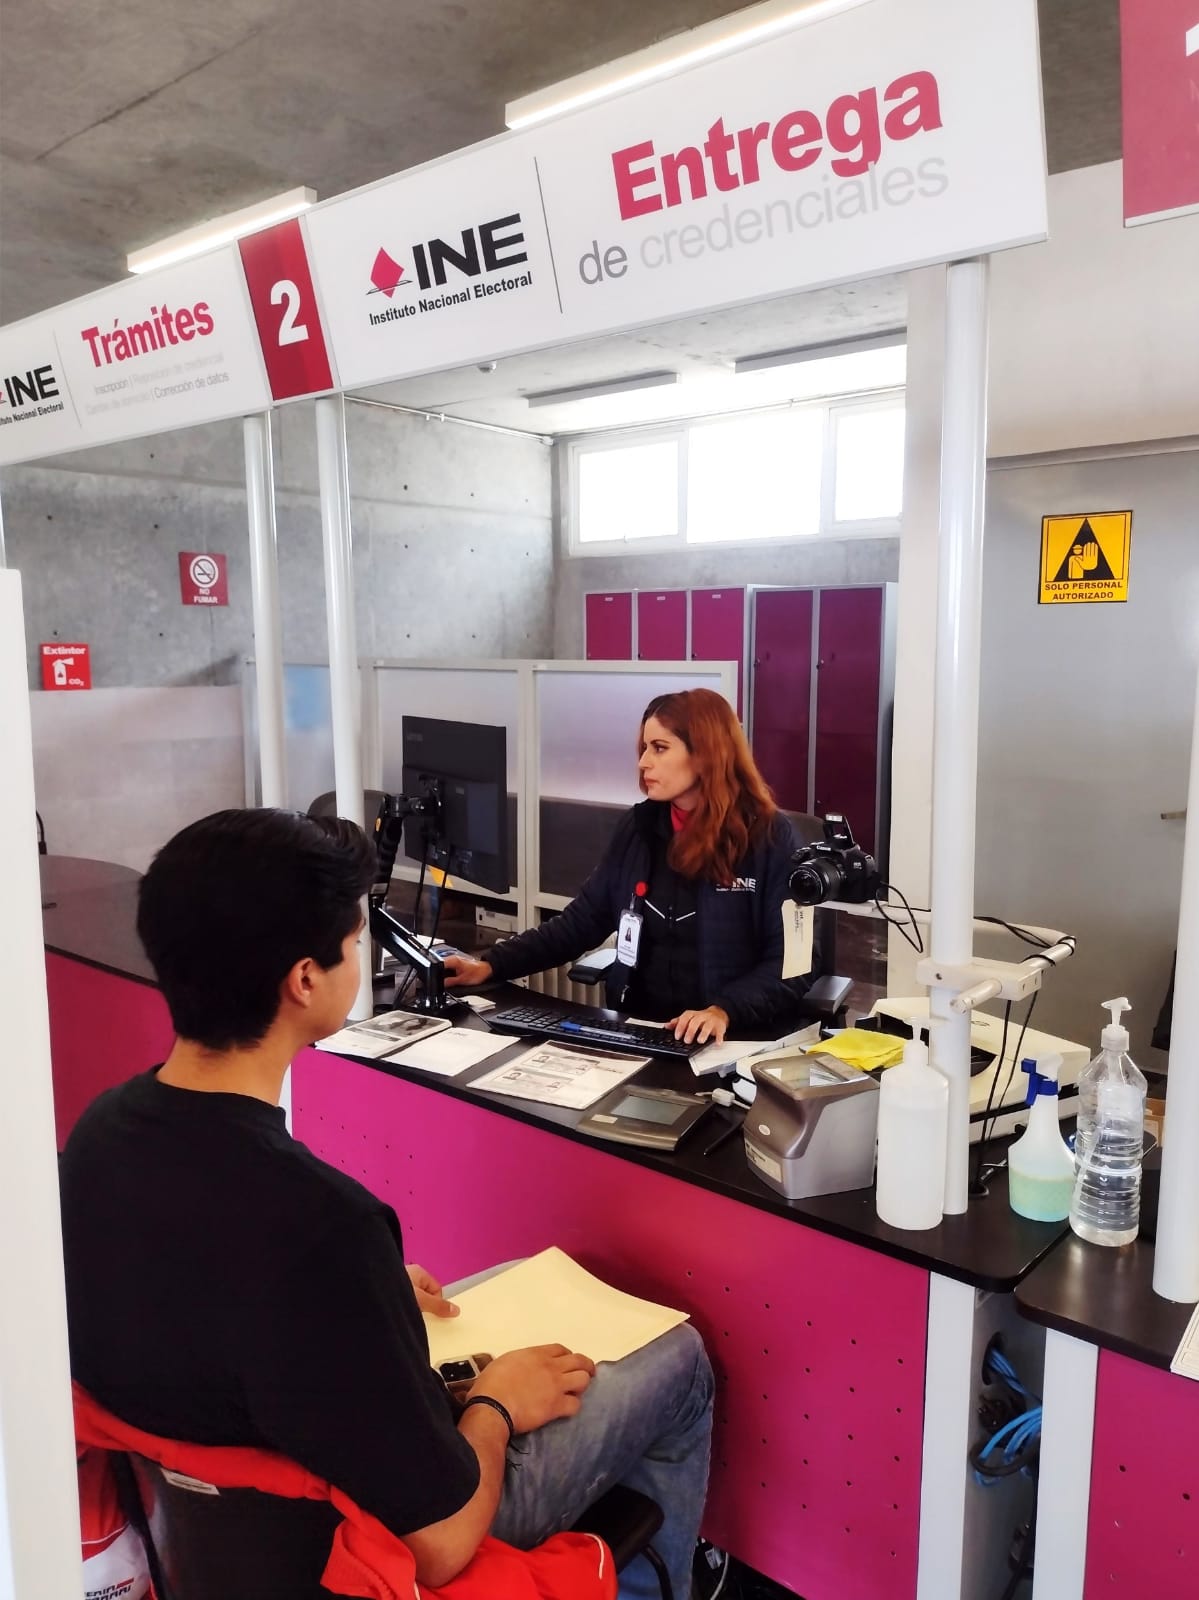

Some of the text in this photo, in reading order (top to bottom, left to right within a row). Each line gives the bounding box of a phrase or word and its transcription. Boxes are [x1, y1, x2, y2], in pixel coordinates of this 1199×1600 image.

[611, 70, 943, 221] Entrega
[579, 157, 949, 285] de credenciales
[412, 213, 528, 290] INE
[270, 280, 309, 346] 2
[369, 271, 532, 326] Instituto Nacional Electoral
[81, 301, 214, 367] Trámites
[4, 365, 60, 408] INE
[195, 376, 206, 388] de
[12, 408, 38, 422] Nacional
[37, 401, 64, 416] Electoral
[193, 595, 218, 604] FUMAR
[199, 588, 210, 596] NO
[1045, 581, 1123, 591] SOLO PERSONAL
[1053, 591, 1114, 600] AUTORIZADO
[43, 645, 86, 656] Extintor
